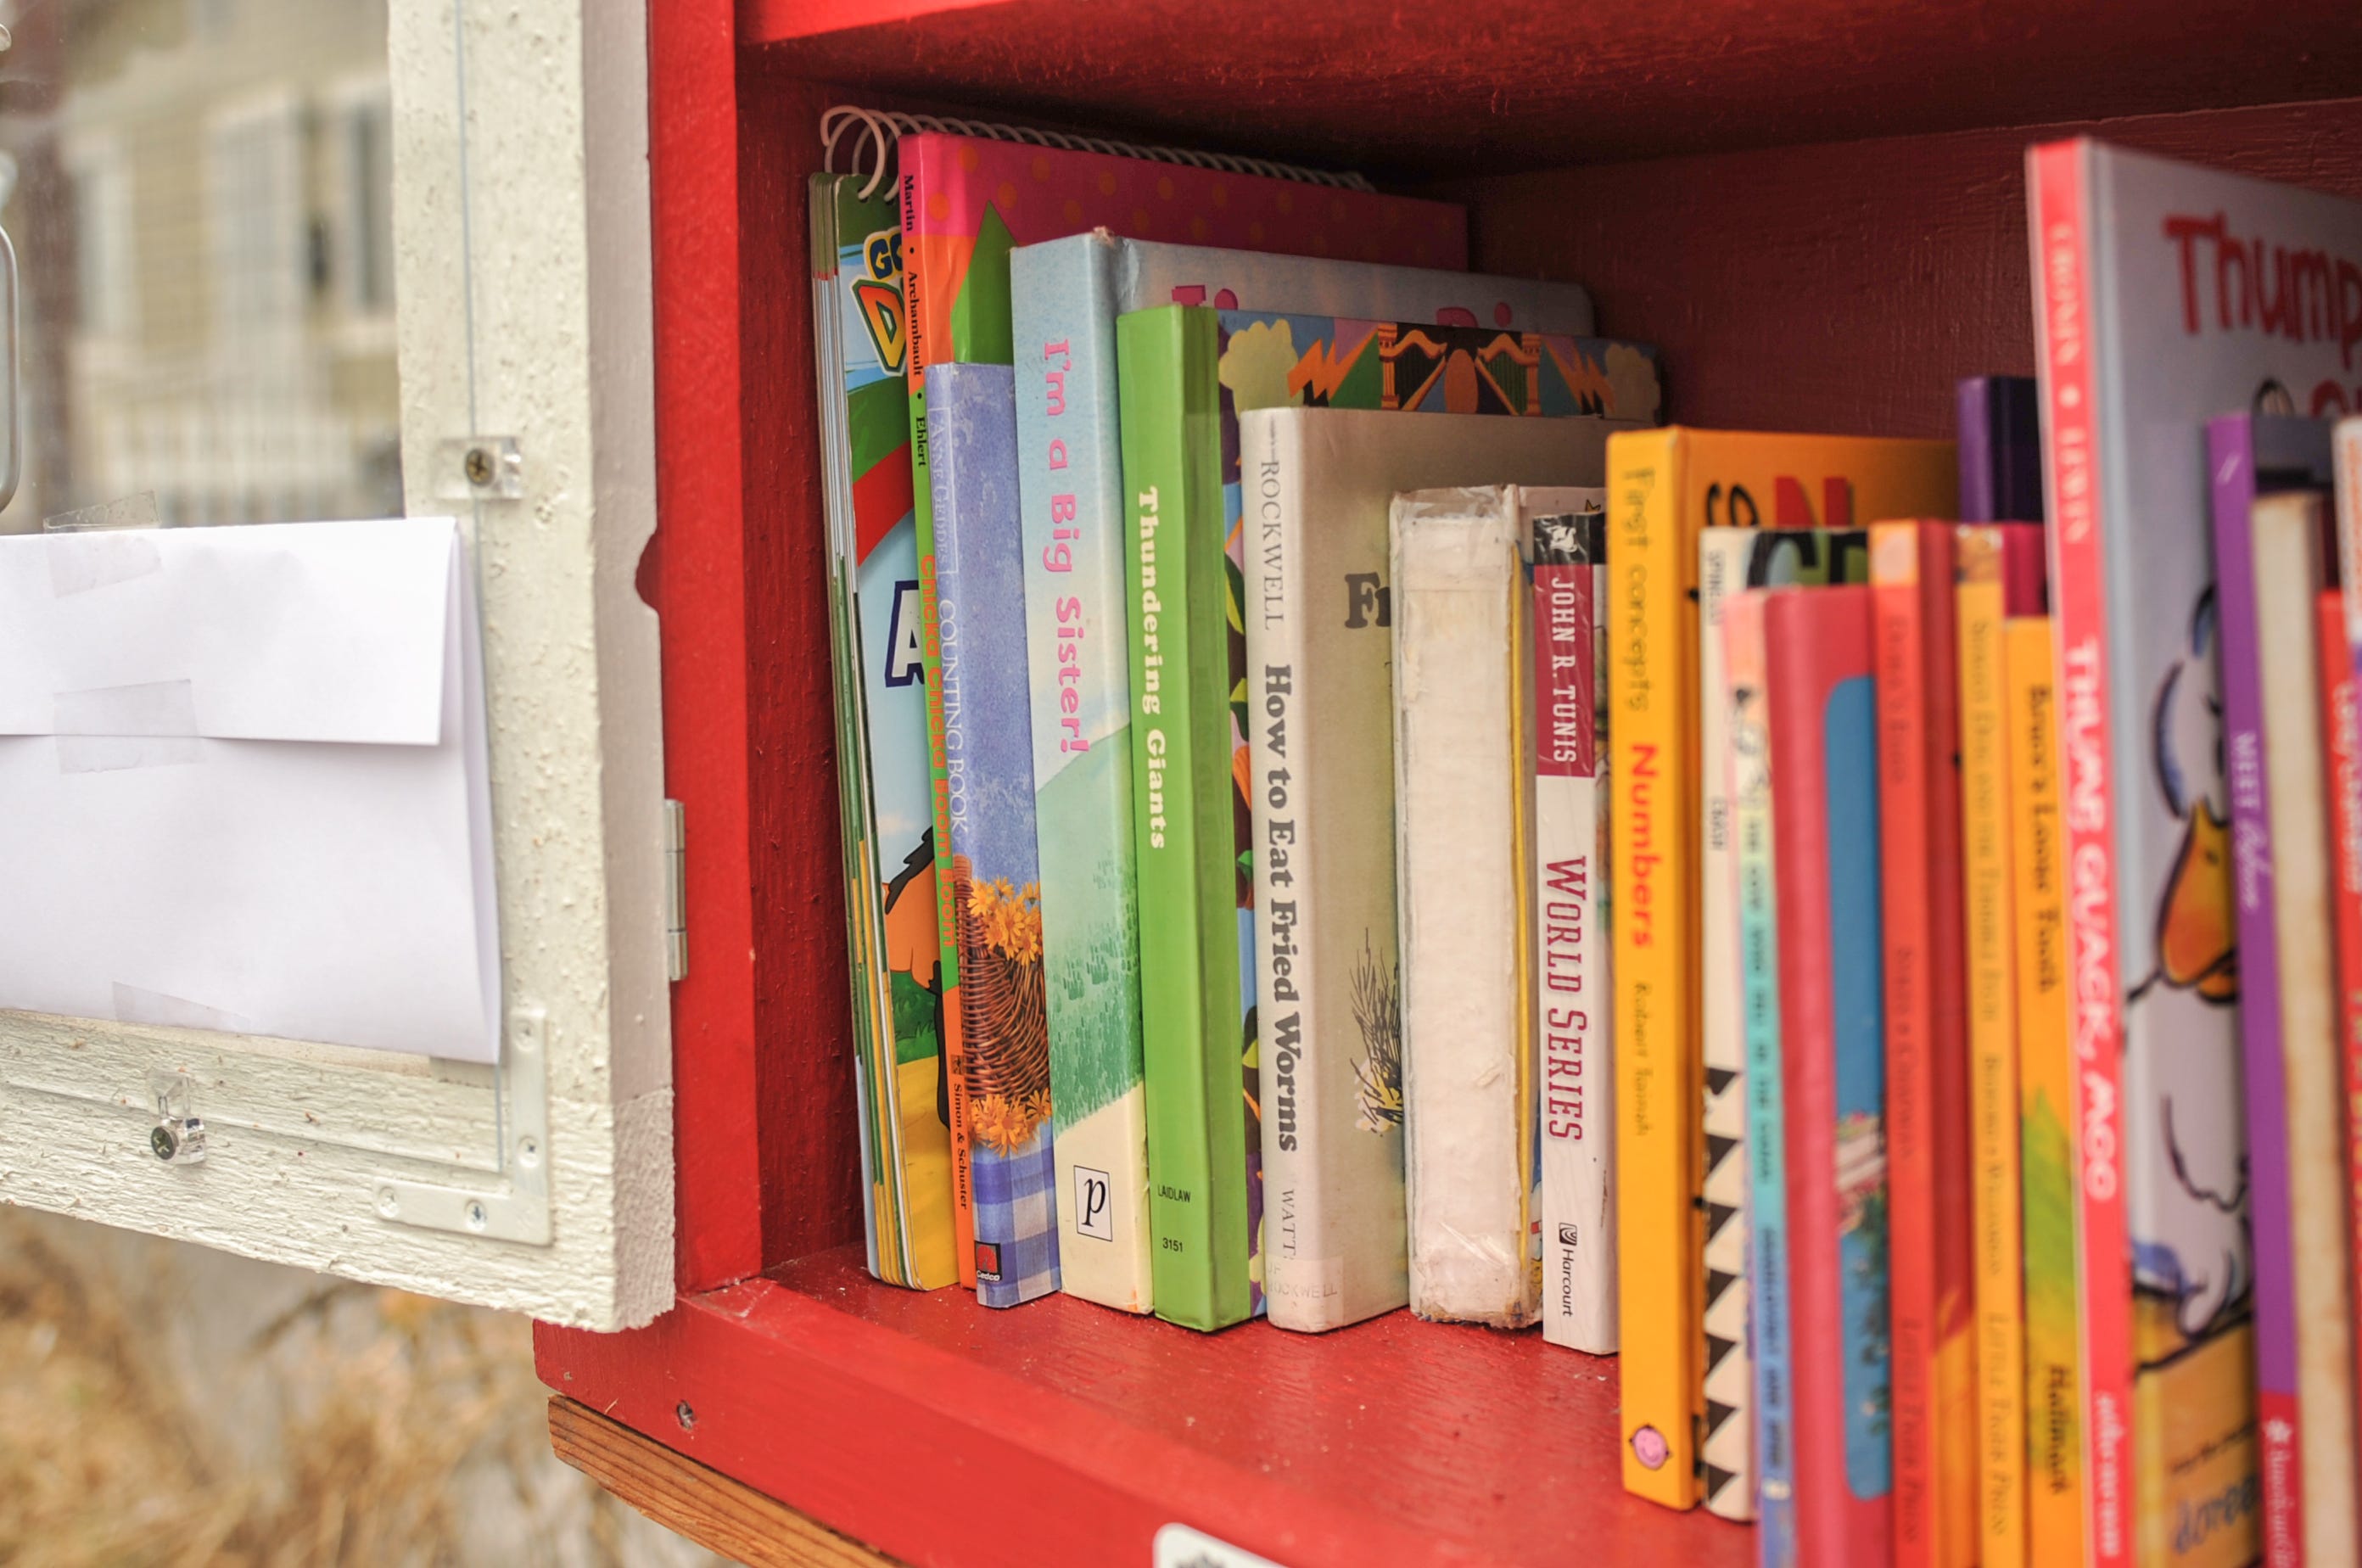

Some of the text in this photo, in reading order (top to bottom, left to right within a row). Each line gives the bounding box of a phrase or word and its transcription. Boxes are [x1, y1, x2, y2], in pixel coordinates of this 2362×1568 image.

[904, 175, 926, 467] Martin Archambault Ehlert
[1043, 339, 1091, 753] I'm a Big Sister!
[938, 598, 965, 752] COUNTING
[1139, 484, 1167, 848] Thundering Giants
[1552, 577, 1576, 764] JOHN R. TUNIS
[921, 555, 956, 948] Chicka Chicka Boom Boom
[947, 758, 969, 834] BOOK
[1261, 460, 1301, 1152] ROCKWELL How to Eat Fried Worms
[2233, 732, 2260, 810] MEET
[1630, 743, 1663, 950] Numbers
[1545, 855, 1587, 1141] WORLD SERIES
[954, 1083, 967, 1210] Simon & Schuster
[1157, 1184, 1191, 1203] LAIDLAW
[2082, 1072, 2118, 1201] MOO
[1162, 1237, 1184, 1253] 3151
[1282, 1190, 1296, 1261] WATT
[1563, 1249, 1574, 1317] Harcourt
